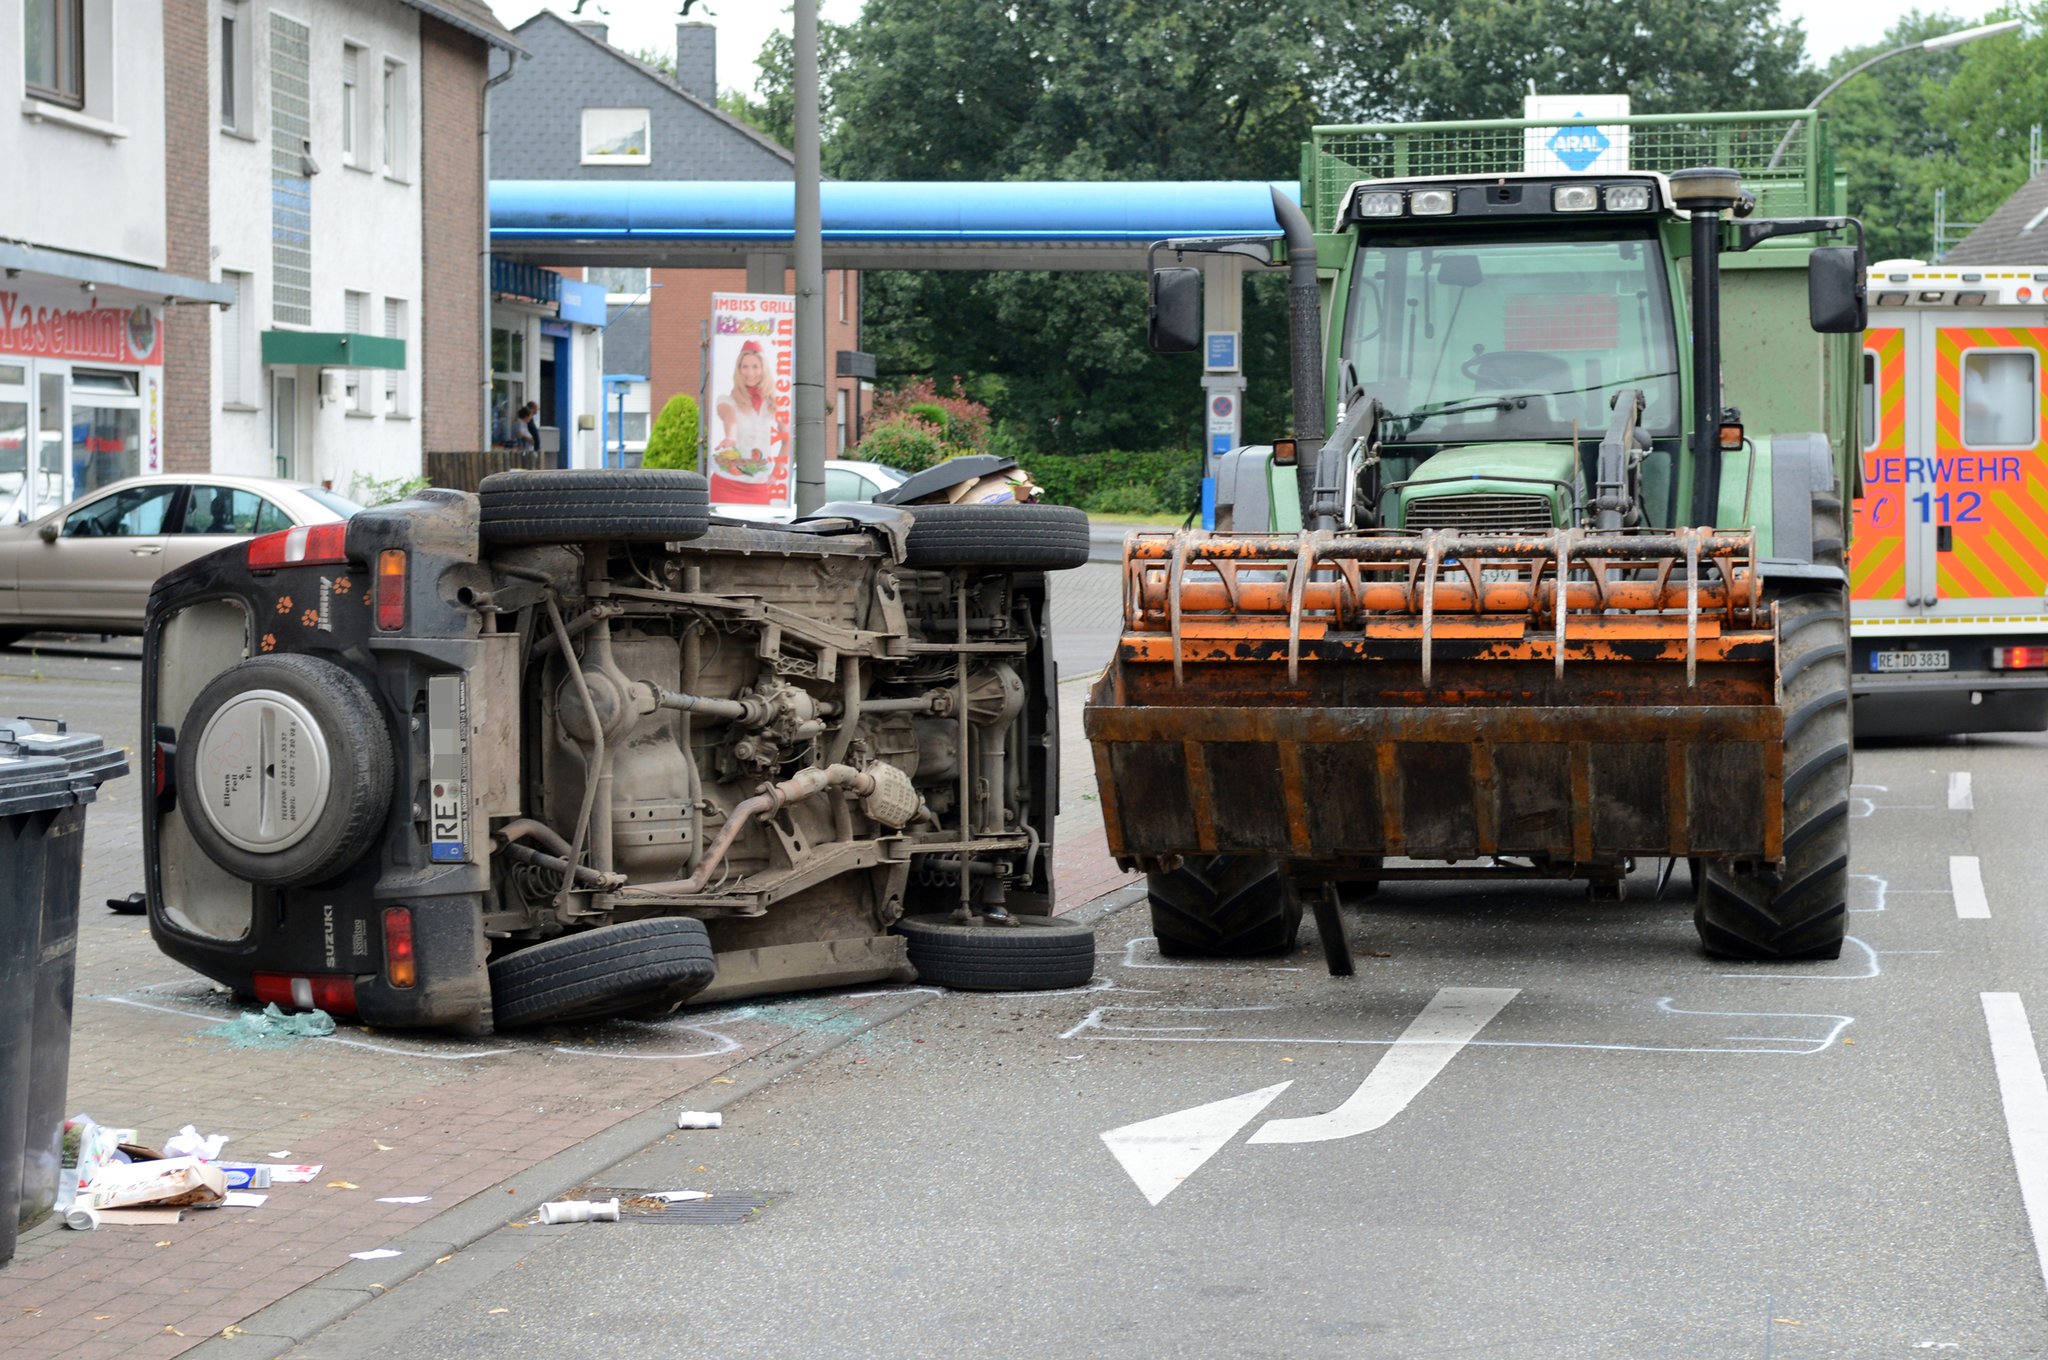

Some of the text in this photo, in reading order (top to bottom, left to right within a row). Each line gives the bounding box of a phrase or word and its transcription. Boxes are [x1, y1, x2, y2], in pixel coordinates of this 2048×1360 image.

[1554, 135, 1603, 152] ARAL
[0, 291, 117, 357] Yasemin
[715, 299, 795, 314] IMBISS GRILL
[768, 318, 793, 501] Bei Yasemin
[1912, 491, 1982, 523] 112
[318, 576, 333, 633] Jimny
[1879, 654, 1893, 668] RE
[1919, 653, 1947, 667] 3831
[435, 802, 458, 840] RE
[323, 905, 335, 968] SUZUKI
